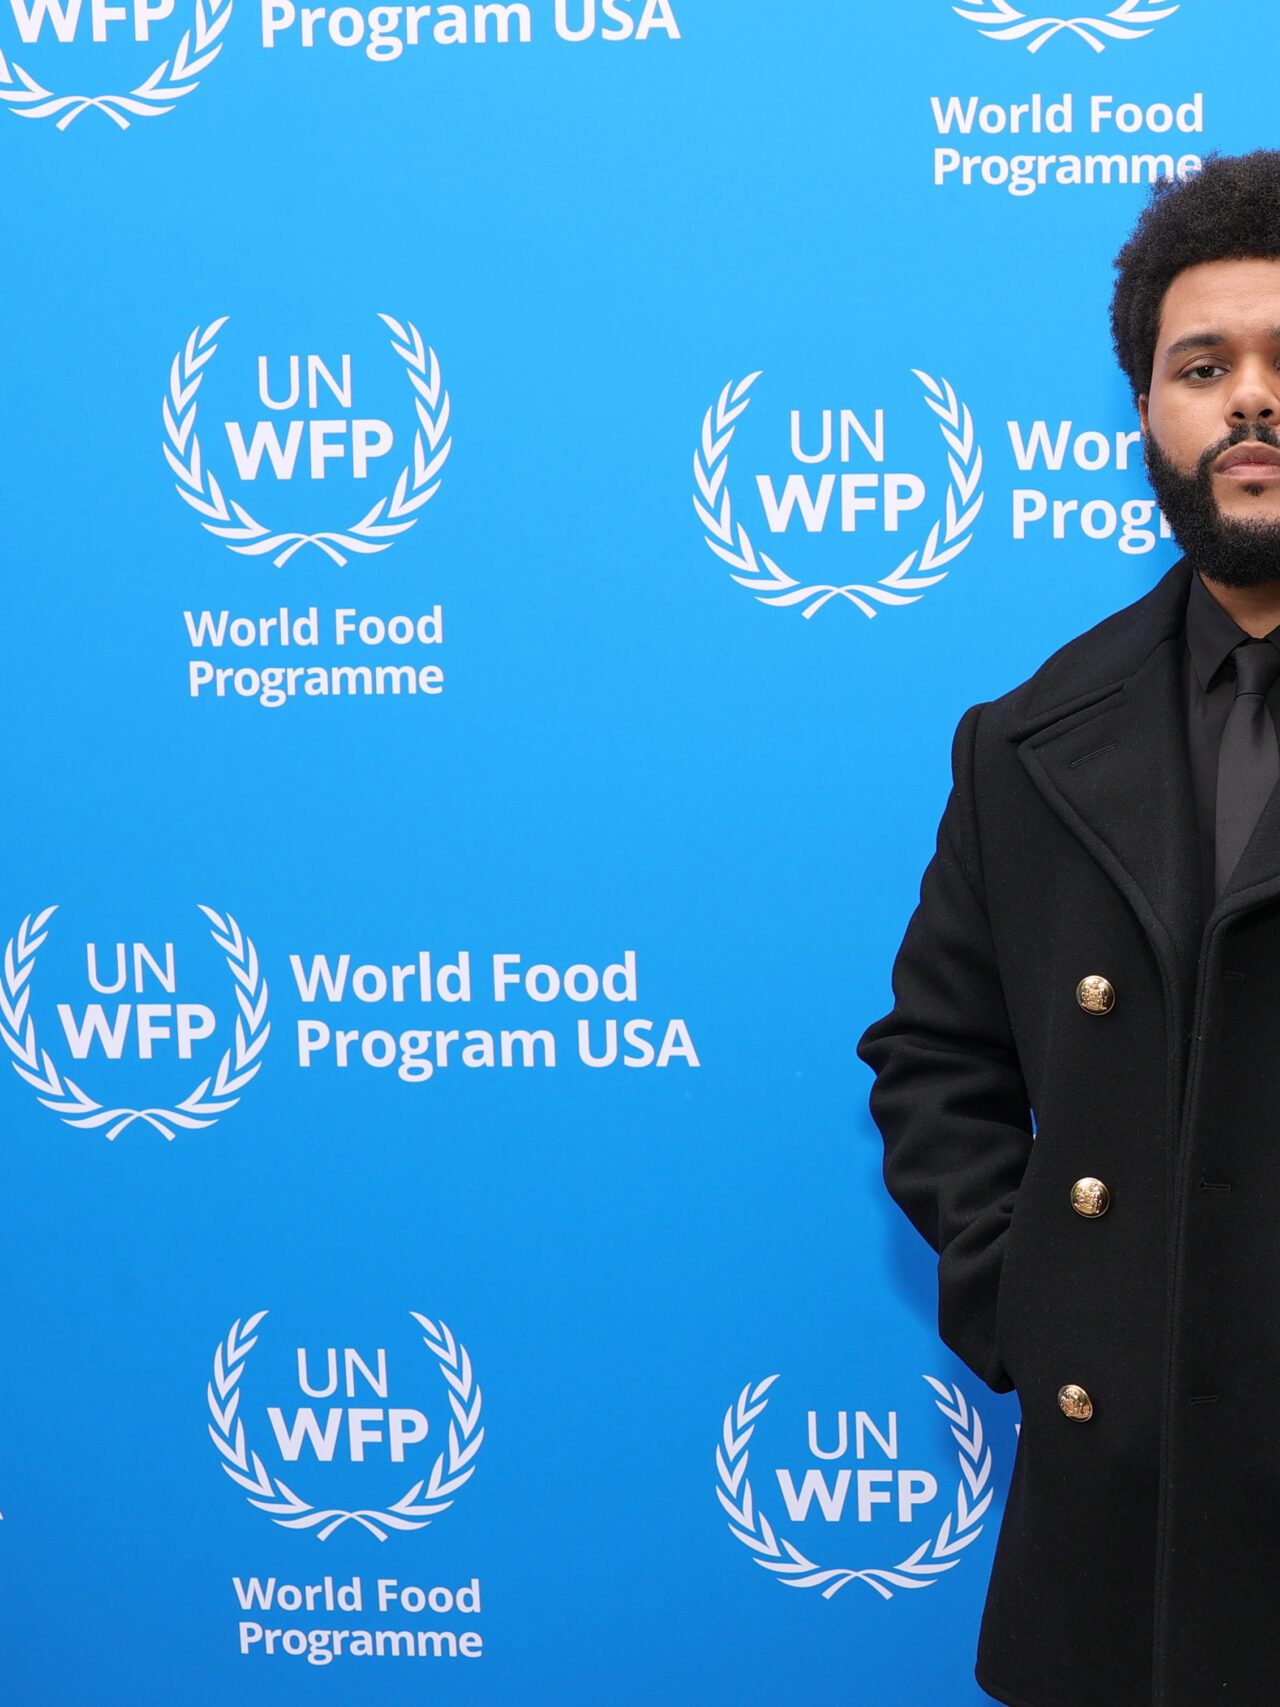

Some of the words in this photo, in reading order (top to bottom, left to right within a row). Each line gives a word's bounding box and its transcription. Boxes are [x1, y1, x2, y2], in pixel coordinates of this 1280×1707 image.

[9, 0, 176, 43] WFP
[260, 0, 532, 62] Program
[554, 0, 682, 43] USA
[929, 92, 1073, 135] World
[1090, 92, 1204, 134] Food
[933, 147, 1203, 197] Programme
[257, 353, 353, 411] UN
[224, 418, 394, 481] WFP
[790, 408, 885, 464] UN
[1006, 420, 1142, 471] Wor
[755, 472, 926, 533] WFP
[1012, 488, 1172, 555] Prog
[183, 606, 319, 648] World
[335, 604, 444, 647] Food
[188, 660, 445, 708] Programme
[86, 942, 176, 995] UN
[289, 950, 471, 1003] World
[492, 950, 638, 1003] Food
[56, 1003, 216, 1060] WFP
[297, 1019, 557, 1083] Program
[577, 1018, 701, 1068] USA
[297, 1347, 388, 1398] UN
[266, 1407, 429, 1463] WFP
[807, 1410, 898, 1460] UN
[775, 1469, 938, 1523] WFP
[232, 1576, 363, 1612] World
[377, 1578, 481, 1613] Food
[239, 1621, 483, 1666] Programme
